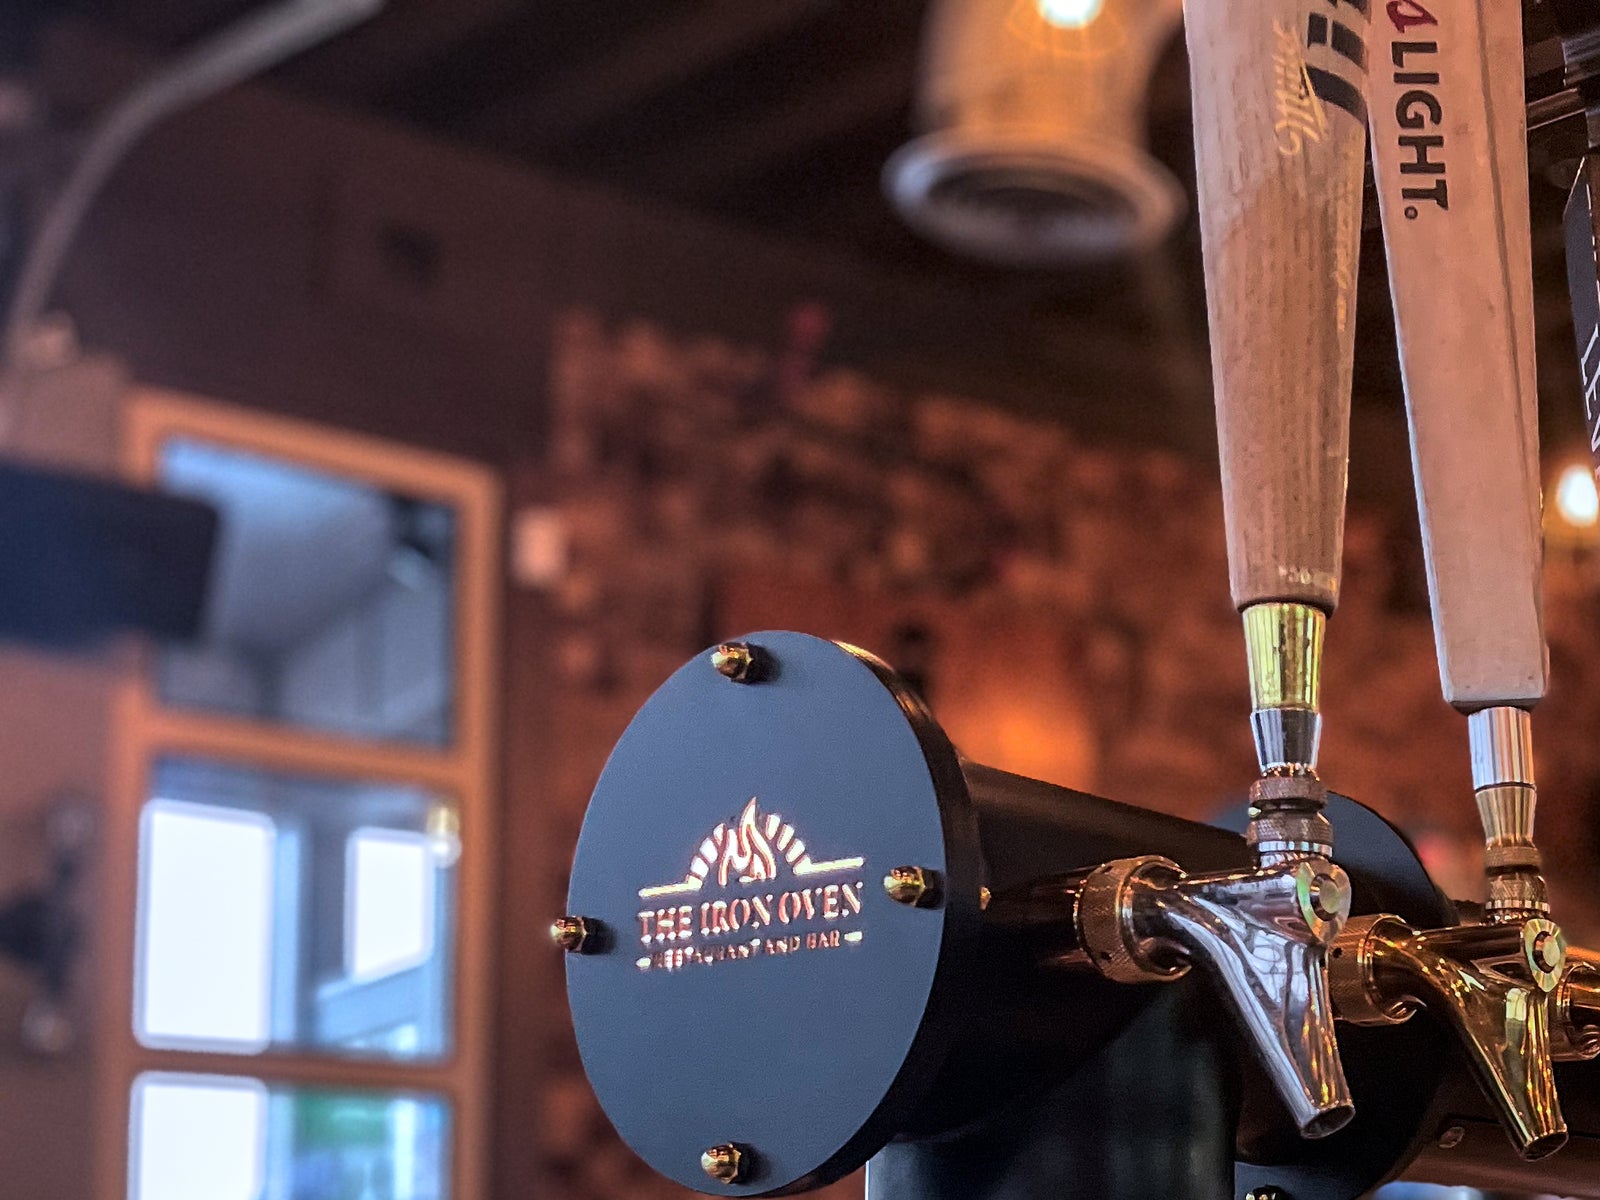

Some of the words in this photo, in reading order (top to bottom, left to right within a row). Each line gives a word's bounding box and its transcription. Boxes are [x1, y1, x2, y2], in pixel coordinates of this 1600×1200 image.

[638, 906, 693, 944] THE
[700, 894, 774, 936] IRON
[778, 882, 864, 924] OVEN
[806, 929, 841, 950] BAR
